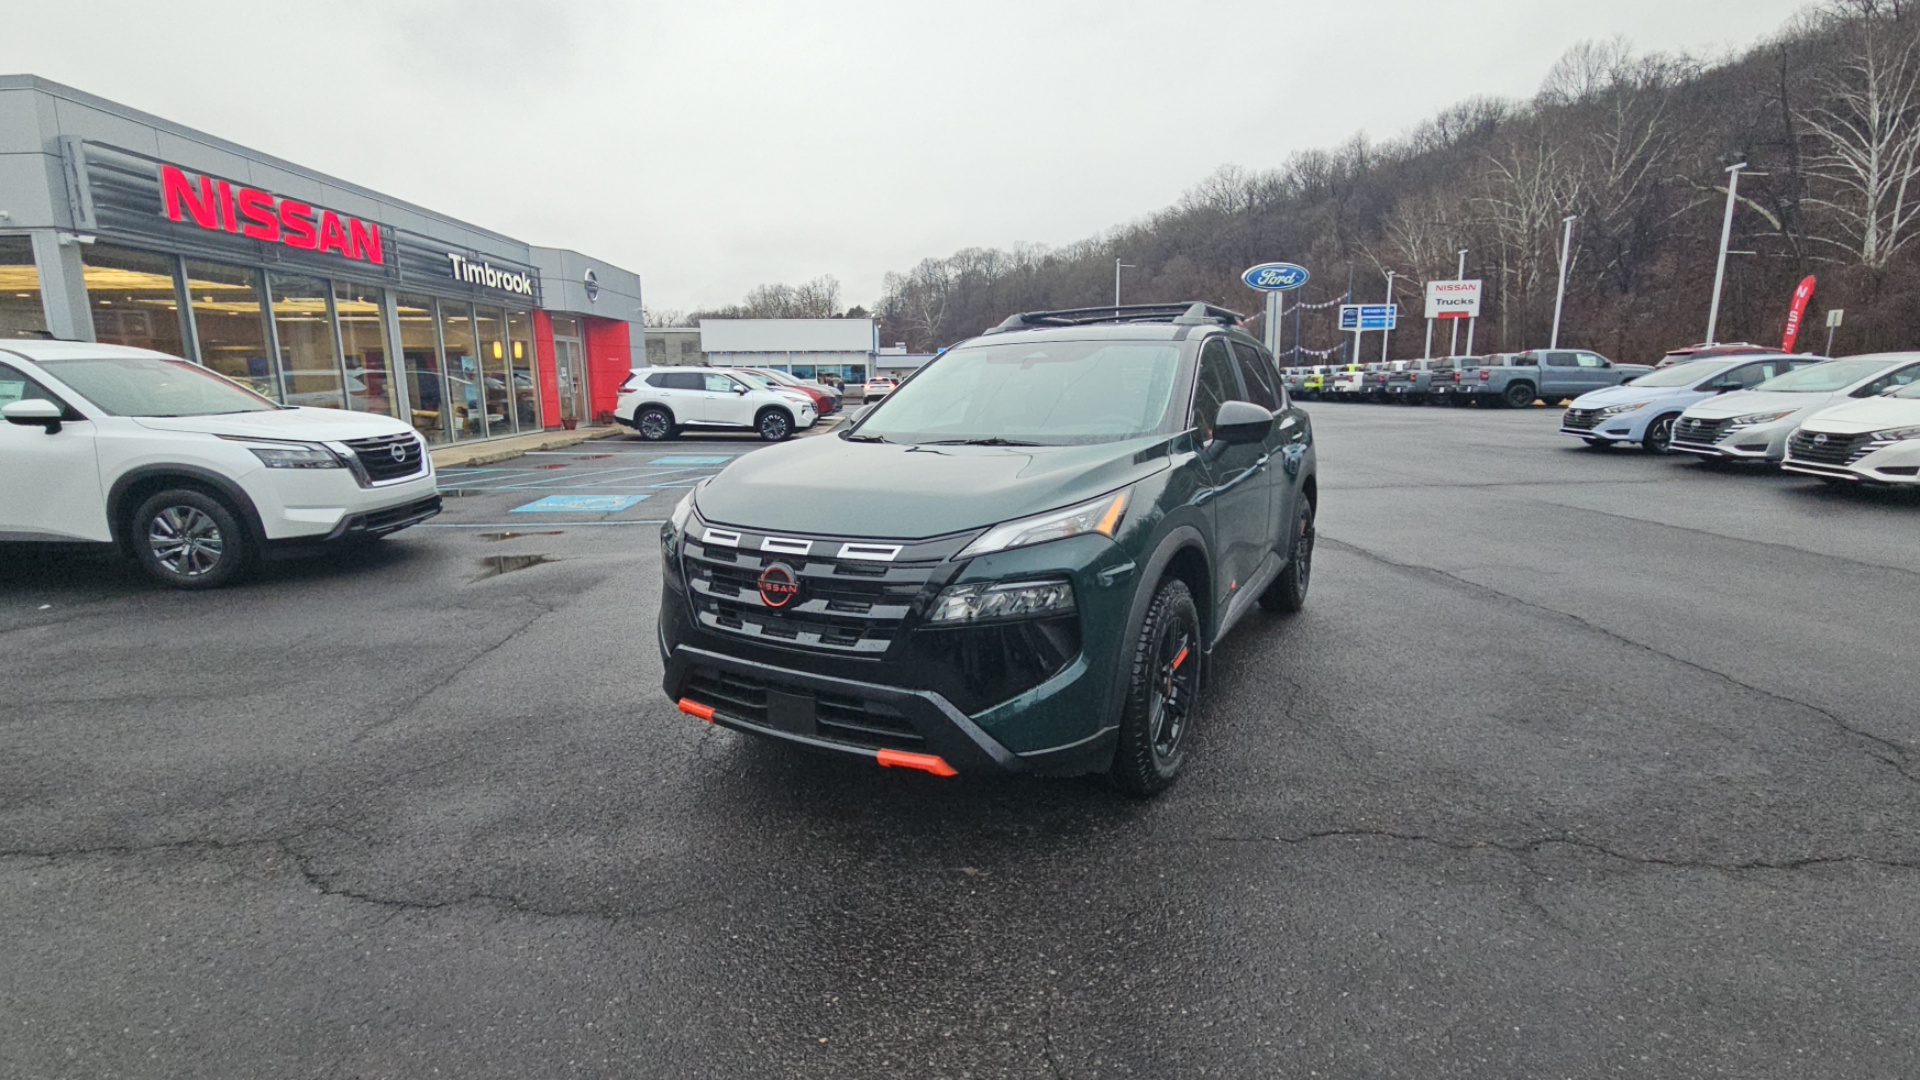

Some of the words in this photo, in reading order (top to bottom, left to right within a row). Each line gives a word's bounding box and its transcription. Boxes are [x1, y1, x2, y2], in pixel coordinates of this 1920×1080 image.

[161, 165, 383, 264] NISSAN
[447, 252, 532, 295] Timbrook
[1257, 268, 1296, 285] Ford
[1435, 284, 1477, 292] NISSAN
[1435, 297, 1475, 306] Trucks
